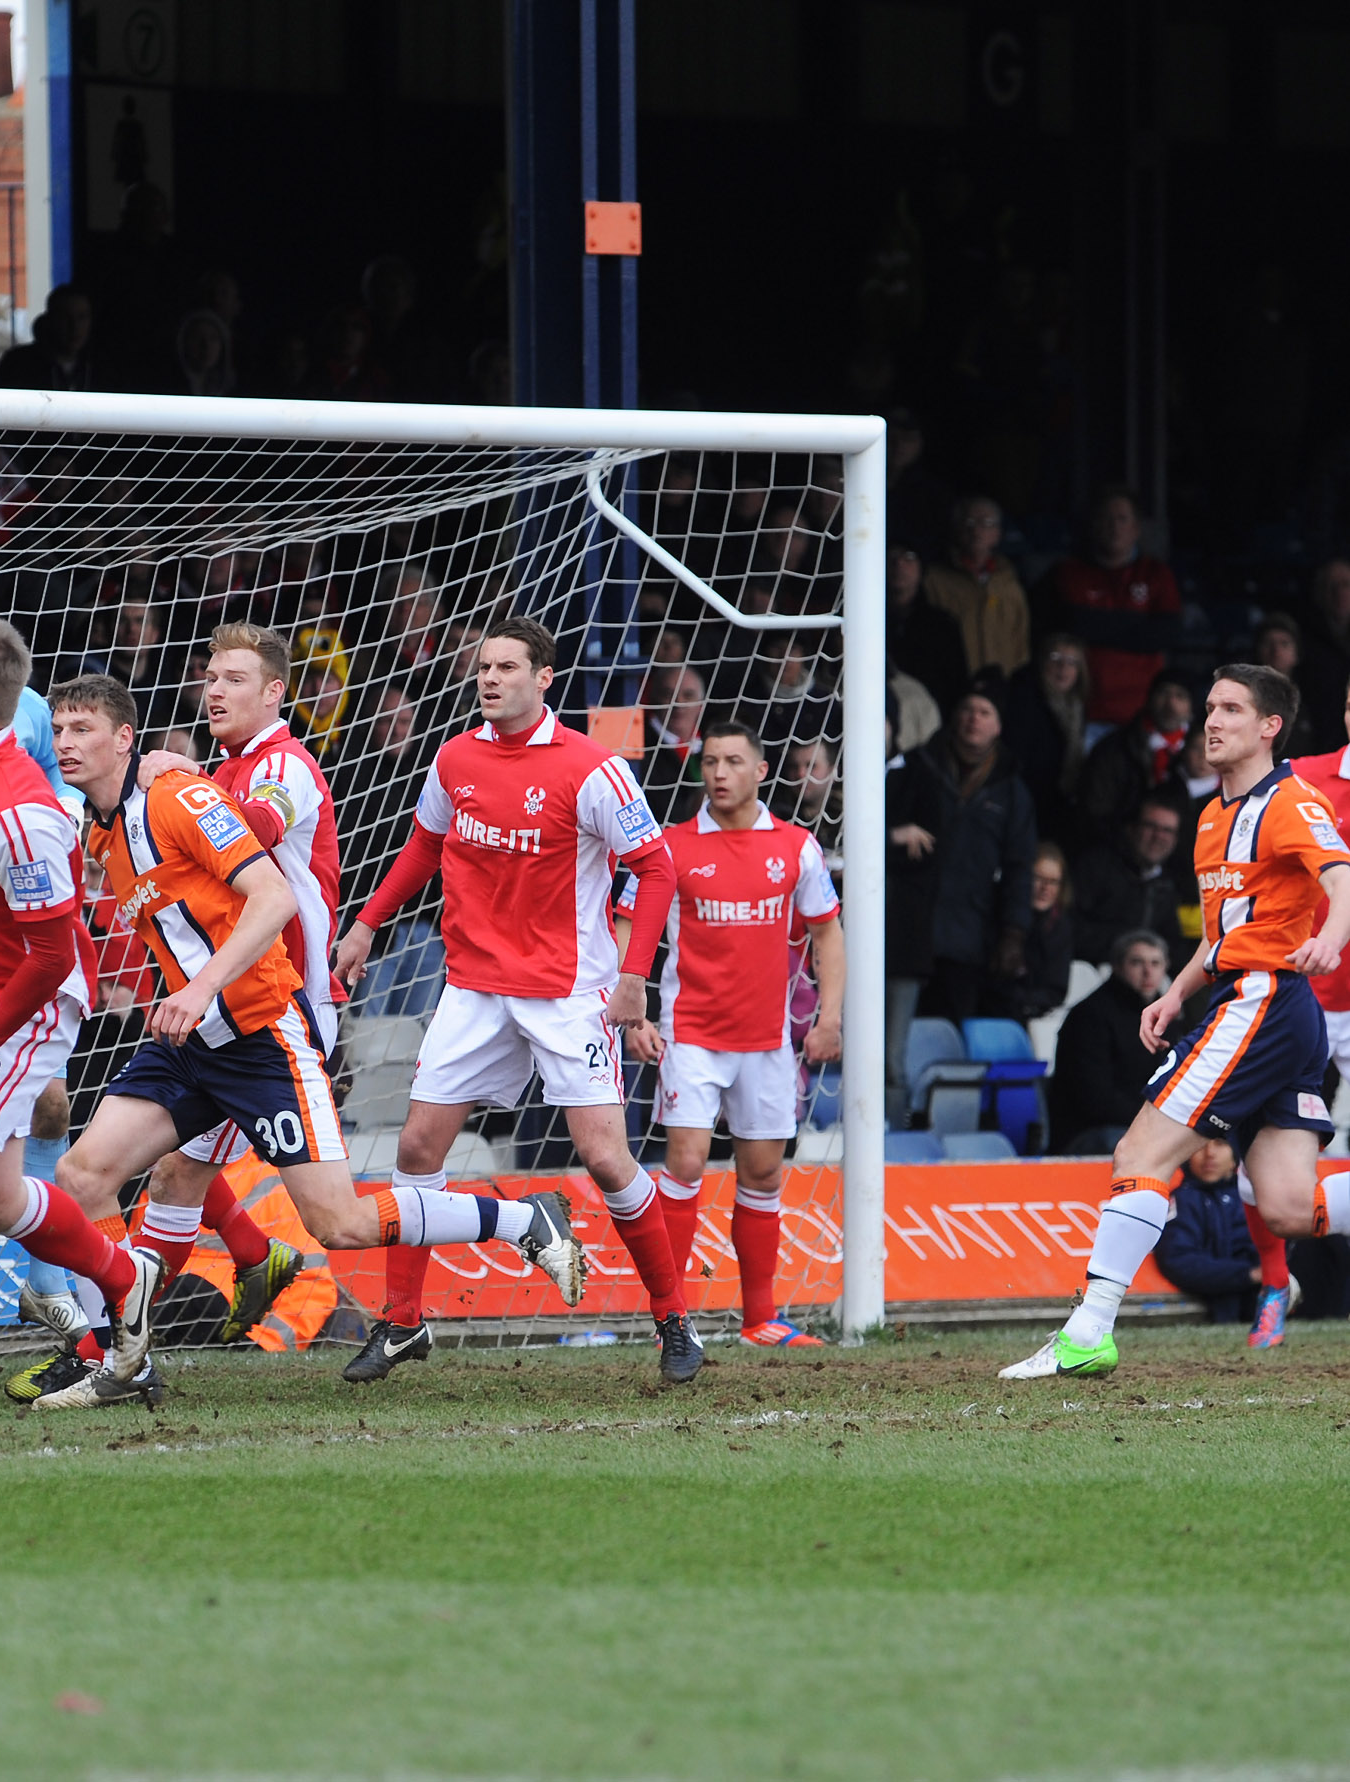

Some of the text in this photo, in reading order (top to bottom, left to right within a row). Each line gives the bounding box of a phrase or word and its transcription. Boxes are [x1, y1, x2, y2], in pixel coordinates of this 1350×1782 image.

[982, 30, 1025, 107] G
[200, 806, 230, 831] BLUE
[617, 800, 644, 821] BLUE
[207, 820, 230, 840] SQ
[456, 807, 541, 854] HIRE-IT!
[622, 814, 643, 832] SQ
[10, 862, 47, 879] BLUE
[13, 877, 37, 890] SQ
[16, 890, 52, 900] PREMIER
[695, 893, 785, 922] HIRE-IT!
[585, 1041, 608, 1069] 21
[255, 1110, 304, 1158] 30
[52, 1305, 70, 1327] 90
